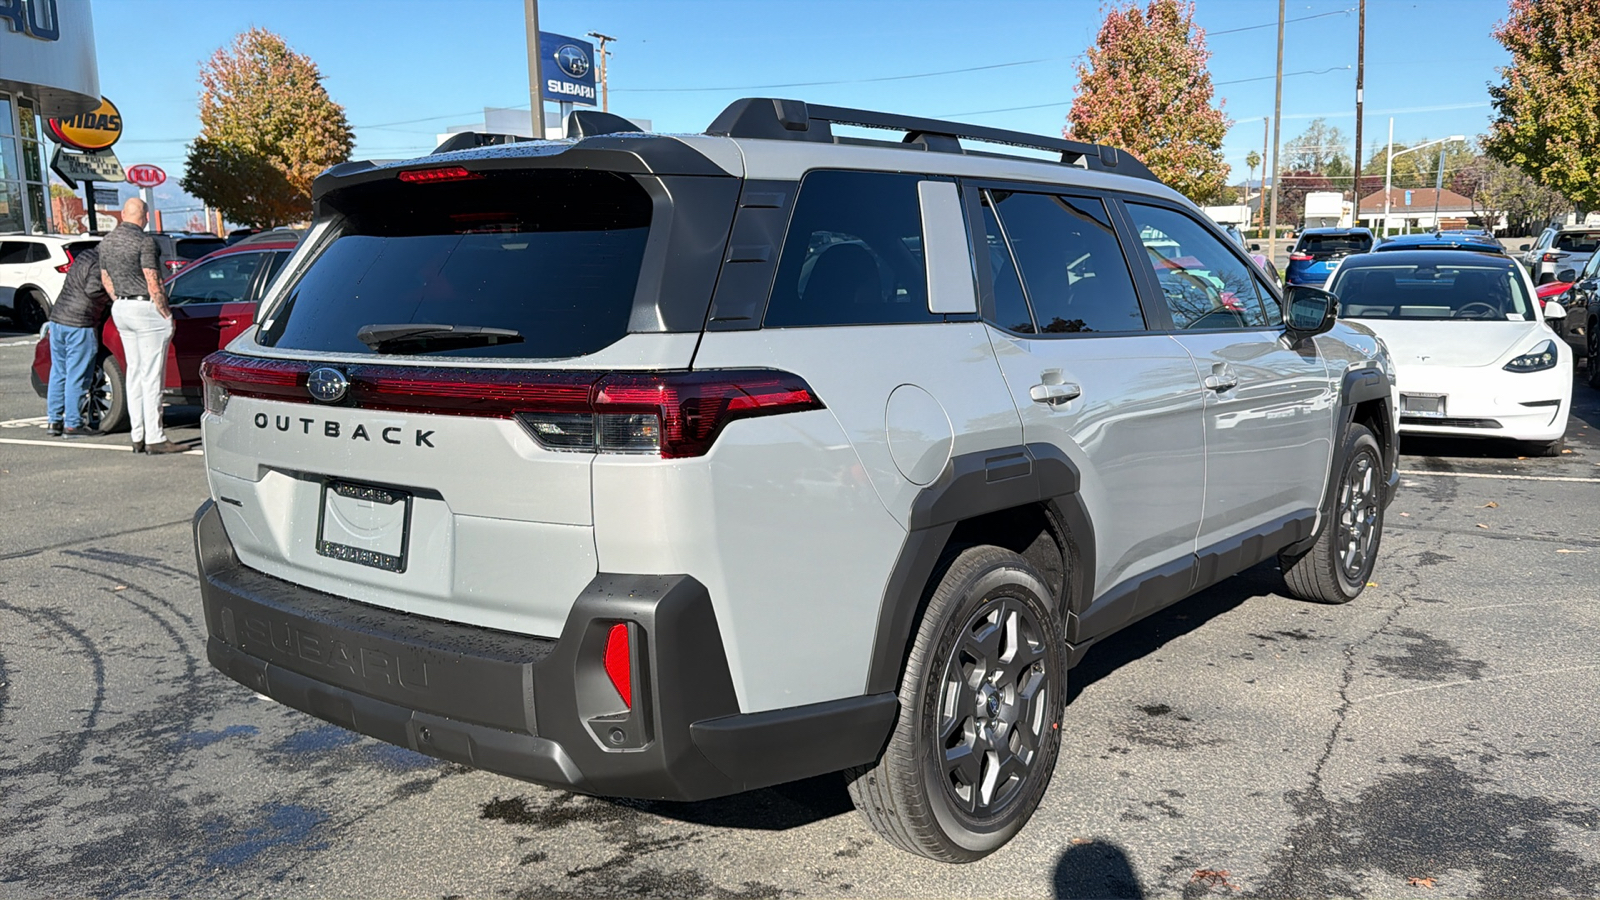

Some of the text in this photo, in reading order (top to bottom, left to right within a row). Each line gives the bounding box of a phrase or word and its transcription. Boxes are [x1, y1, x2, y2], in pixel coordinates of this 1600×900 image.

[547, 80, 594, 98] SUBARU
[57, 112, 119, 131] MIDAS
[134, 168, 160, 182] KIA
[254, 412, 435, 448] OUTBACK
[245, 618, 428, 688] SUBARU
